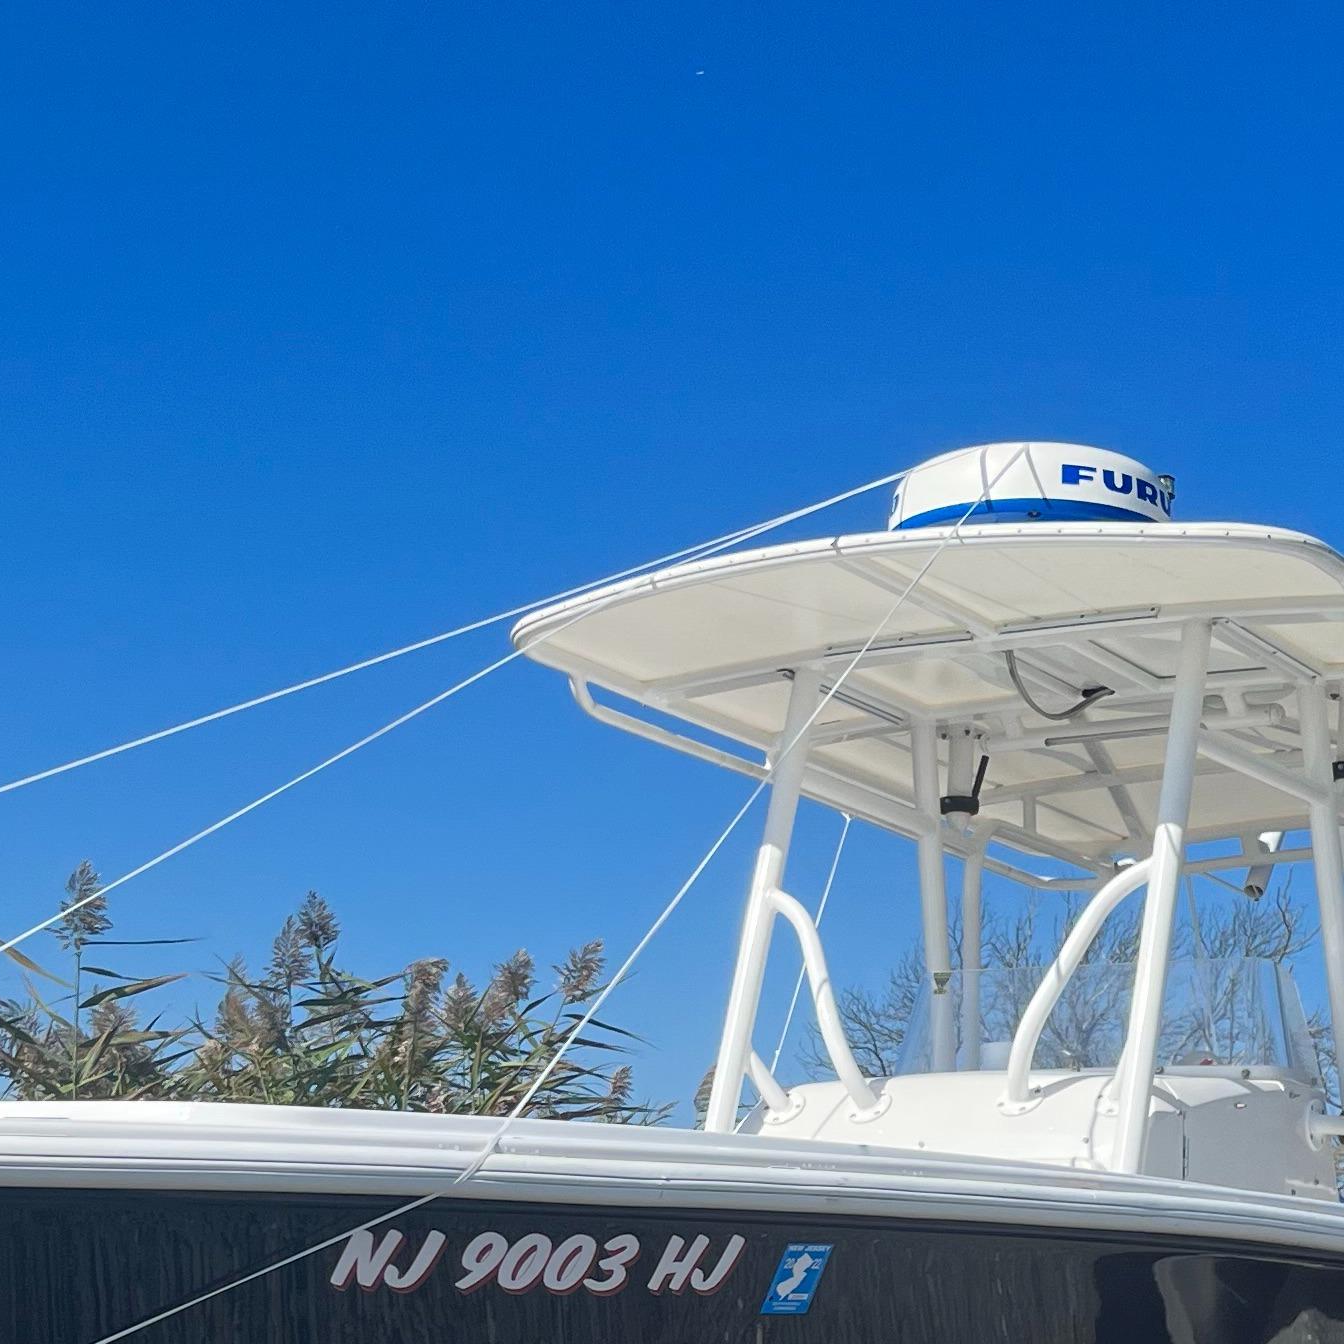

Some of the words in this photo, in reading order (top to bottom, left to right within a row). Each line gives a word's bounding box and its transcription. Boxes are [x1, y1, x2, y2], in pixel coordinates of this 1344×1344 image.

[330, 1228, 447, 1293] NJ
[455, 1231, 639, 1295] 9003
[648, 1233, 746, 1296] HJ
